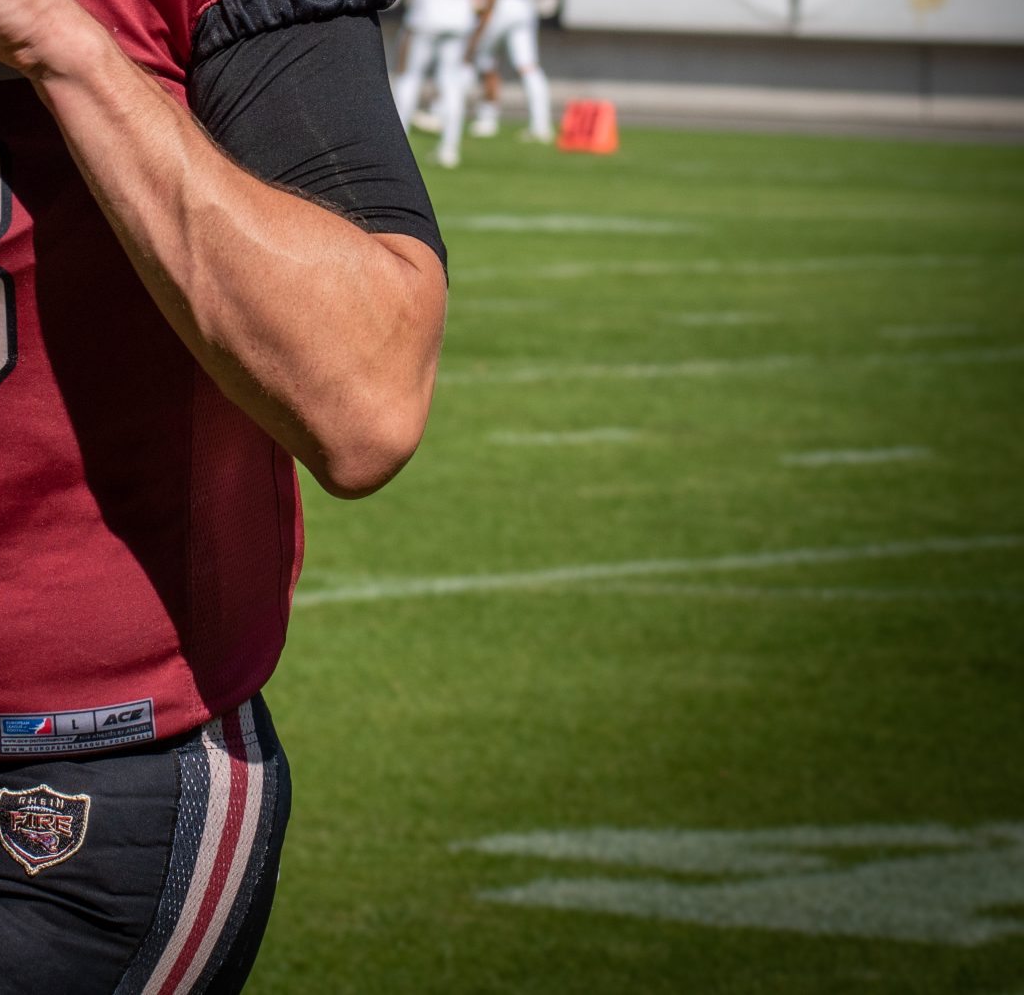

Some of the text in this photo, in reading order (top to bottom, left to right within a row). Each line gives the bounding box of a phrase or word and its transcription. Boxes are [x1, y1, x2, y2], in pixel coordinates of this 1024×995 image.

[72, 719, 79, 729] L
[103, 709, 143, 726] ACE
[18, 796, 64, 809] RHEIN
[10, 810, 73, 837] FIRE
